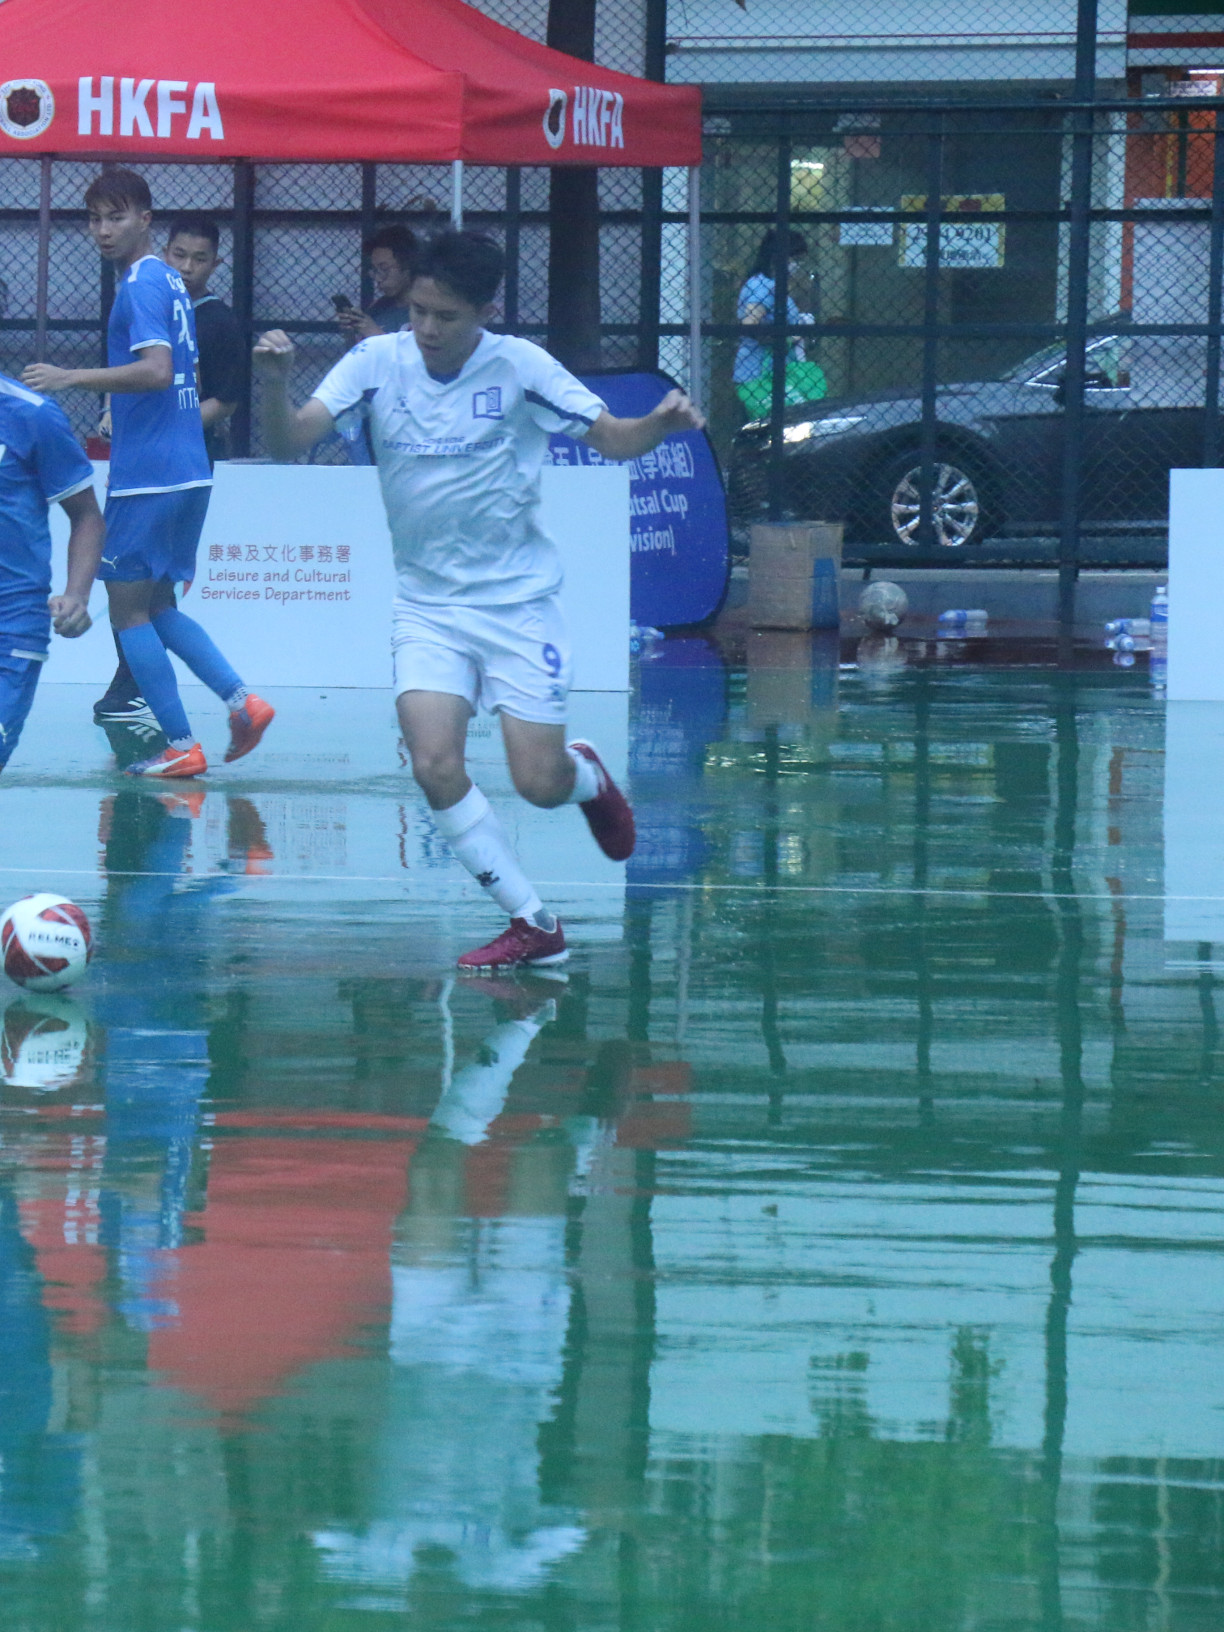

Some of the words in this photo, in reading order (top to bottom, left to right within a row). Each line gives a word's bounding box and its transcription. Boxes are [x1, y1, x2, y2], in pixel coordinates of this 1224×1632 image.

[77, 76, 225, 140] HKFA
[573, 86, 624, 149] HKFA
[630, 490, 661, 517] utsal
[661, 489, 688, 520] Cup
[208, 544, 351, 563] 康樂及文化事務署
[630, 524, 675, 556] vision)
[209, 568, 259, 582] Leisure
[263, 569, 290, 582] and
[294, 568, 351, 582] Cultural
[201, 586, 260, 600] Services
[265, 587, 351, 606] Department
[542, 643, 562, 678] 9
